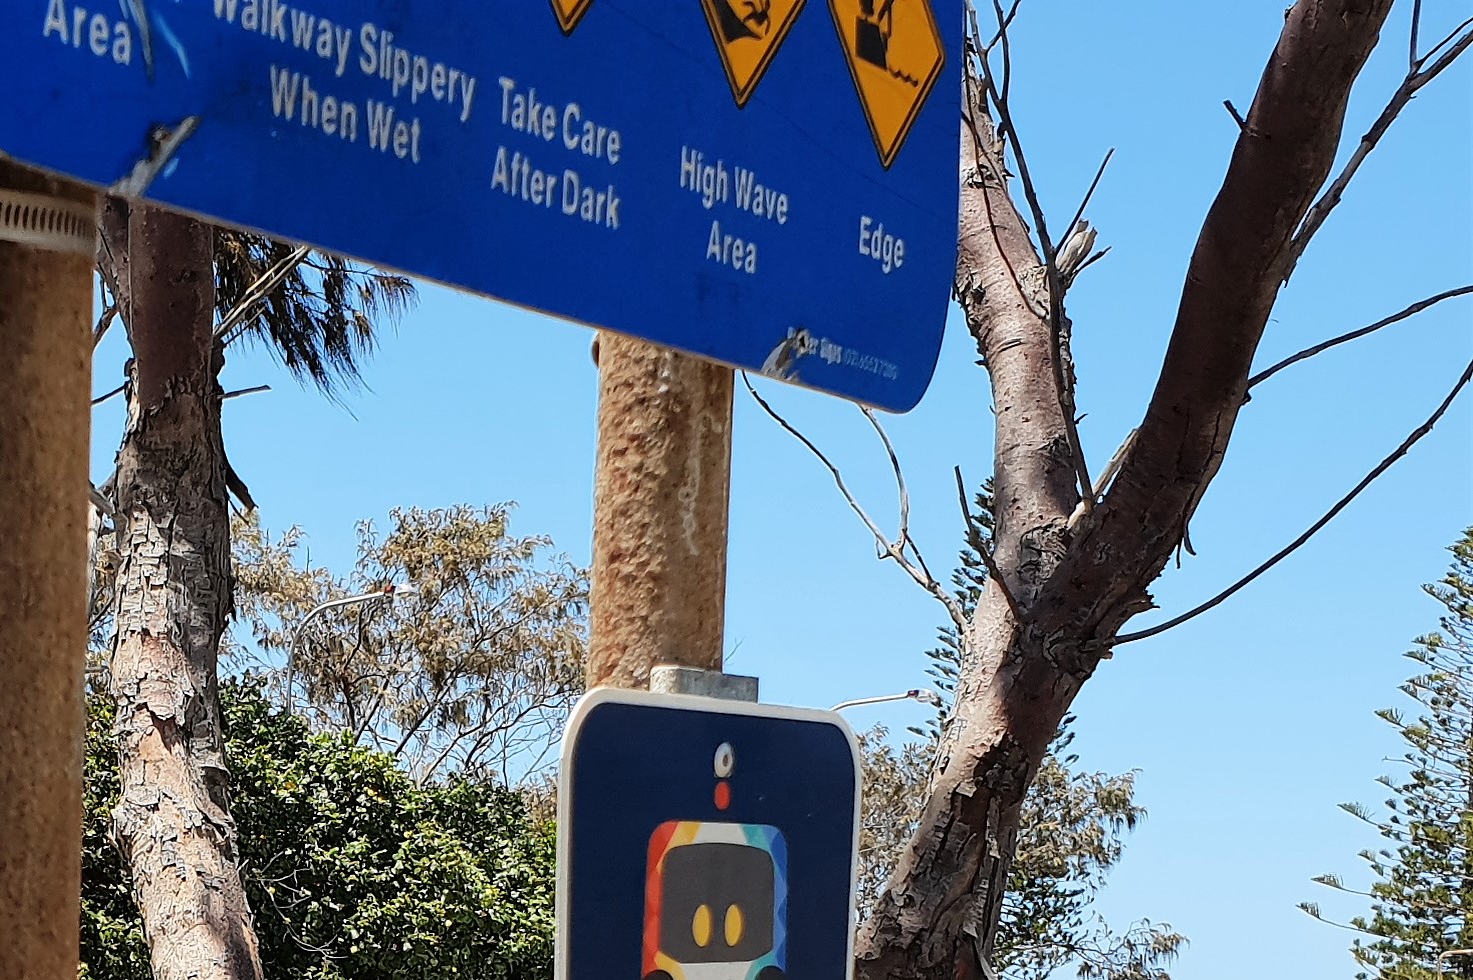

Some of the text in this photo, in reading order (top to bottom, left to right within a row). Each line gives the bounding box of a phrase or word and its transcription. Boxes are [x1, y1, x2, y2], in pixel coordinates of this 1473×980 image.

[42, 0, 132, 66] Area
[359, 22, 477, 123] Slippery
[269, 64, 422, 164] When Wet
[498, 76, 622, 166] Take Care
[490, 145, 621, 230] After Dark
[679, 144, 789, 225] High Wave
[706, 220, 757, 275] Area
[858, 215, 905, 274] Edge
